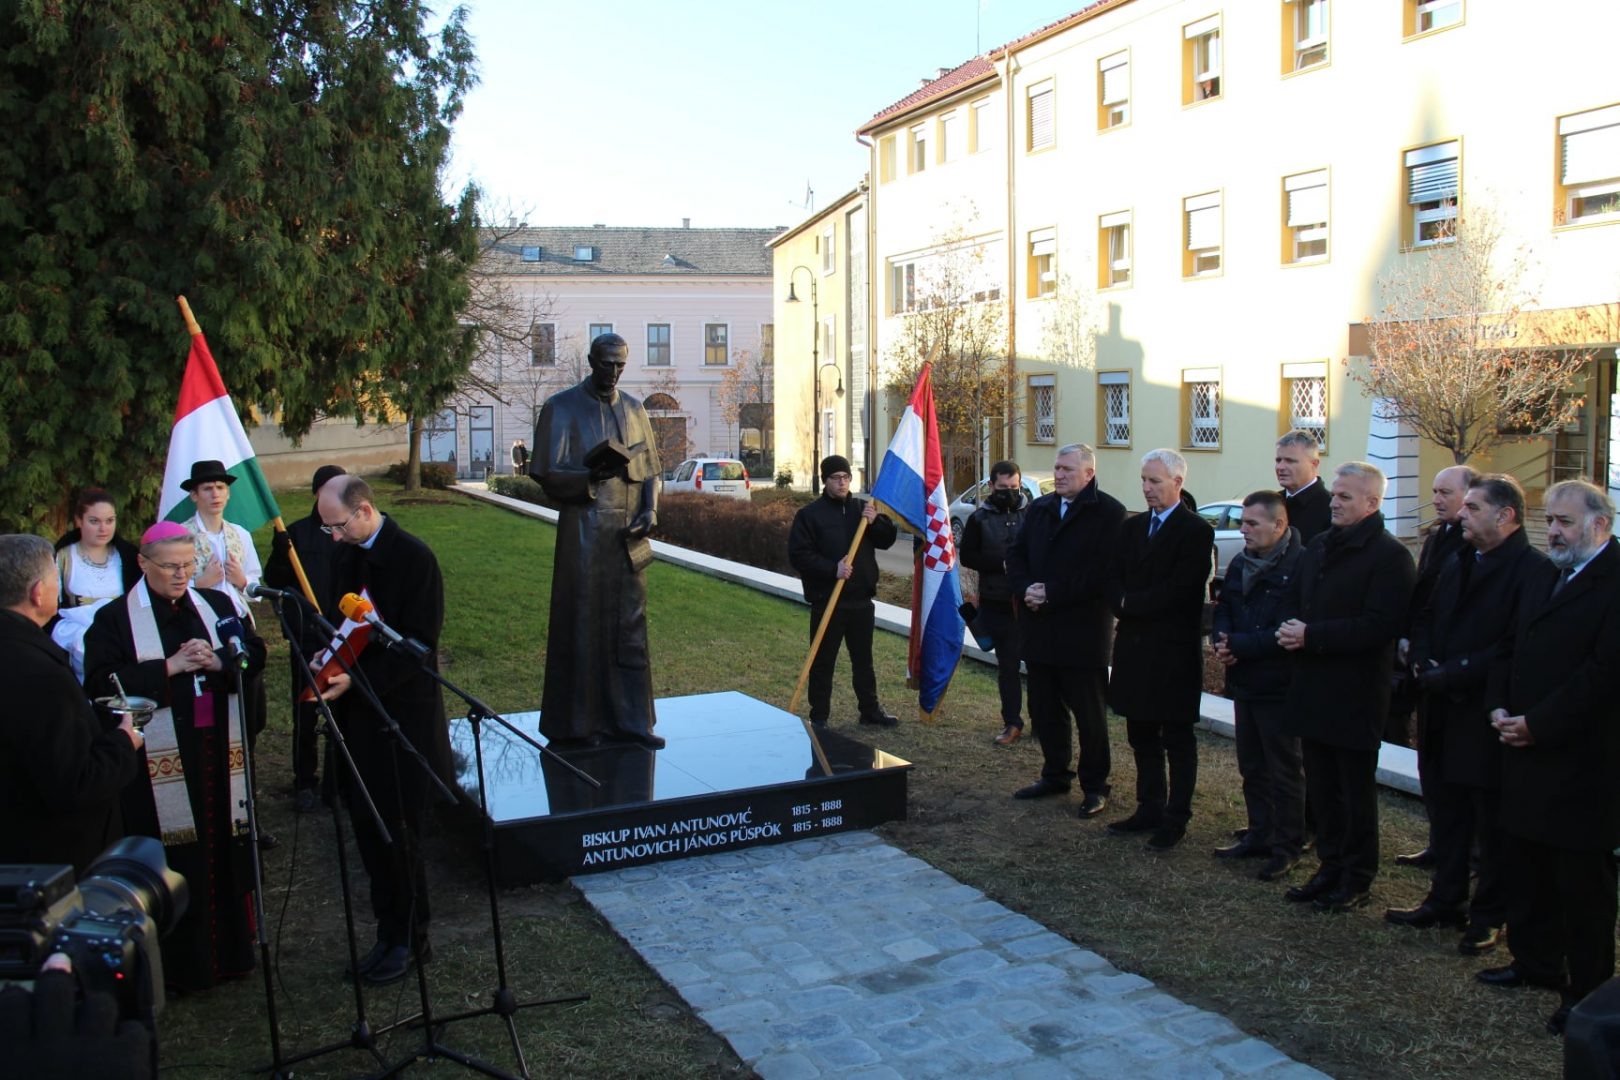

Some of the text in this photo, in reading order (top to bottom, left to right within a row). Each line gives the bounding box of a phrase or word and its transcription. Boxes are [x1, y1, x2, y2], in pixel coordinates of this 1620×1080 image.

[582, 829, 631, 848] BISKUP
[634, 823, 667, 840] IVAN
[670, 806, 752, 835] ANTUNOVIĆ
[791, 804, 811, 817] 1815
[820, 799, 842, 812] 1888
[582, 839, 680, 865] ANTUNOVICH
[683, 831, 727, 853] JÁNOS
[730, 822, 782, 843] PÜSPÖK
[791, 820, 812, 833] 1815
[822, 815, 843, 828] 1888
